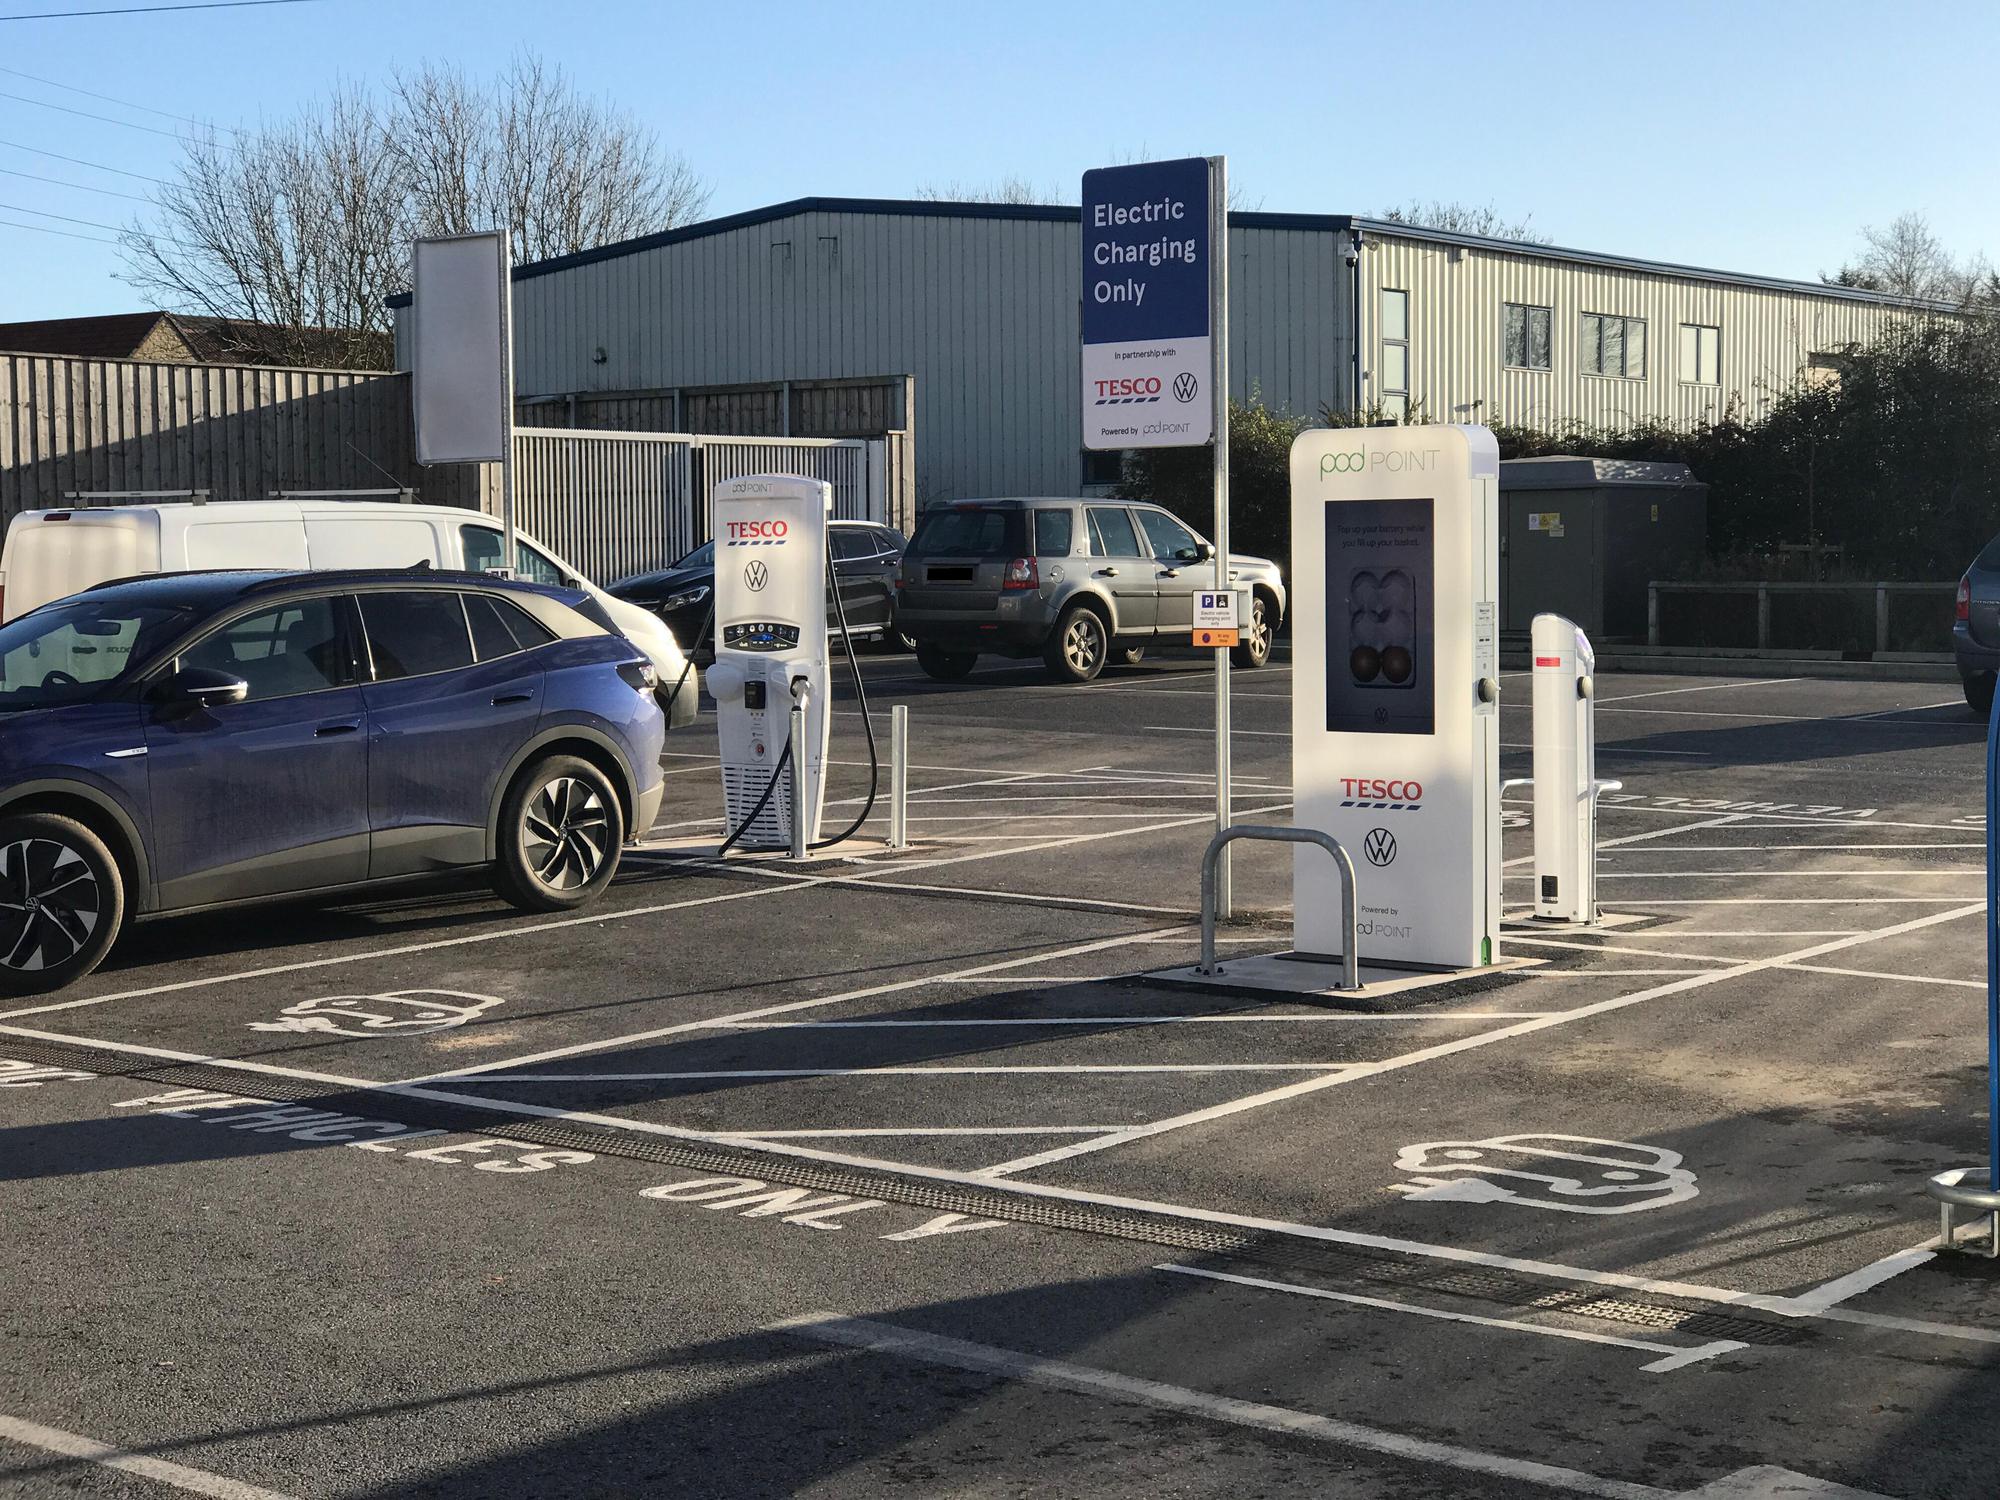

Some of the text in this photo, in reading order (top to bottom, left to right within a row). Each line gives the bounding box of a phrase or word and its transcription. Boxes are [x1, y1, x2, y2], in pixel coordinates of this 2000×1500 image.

[1094, 197, 1185, 227] Electric
[1094, 237, 1196, 267] Charging
[1094, 278, 1146, 306] Only
[1114, 348, 1176, 361] In partnership with
[1095, 377, 1161, 397] TESCO
[1101, 420, 1191, 437] Powered by pod POINT
[1320, 443, 1441, 482] pod POINT
[727, 520, 788, 538] TESCO
[1362, 526, 1378, 535] your
[1342, 540, 1356, 549] you
[1366, 540, 1376, 548] up
[1377, 540, 1393, 548] your
[1340, 778, 1423, 801] TESCO
[1597, 794, 1878, 817] VEHICLE
[1361, 905, 1399, 916] Powered by
[1357, 919, 1413, 938] od POINT
[110, 1087, 596, 1173] VEHICLES
[638, 1176, 1009, 1241] ONLY
